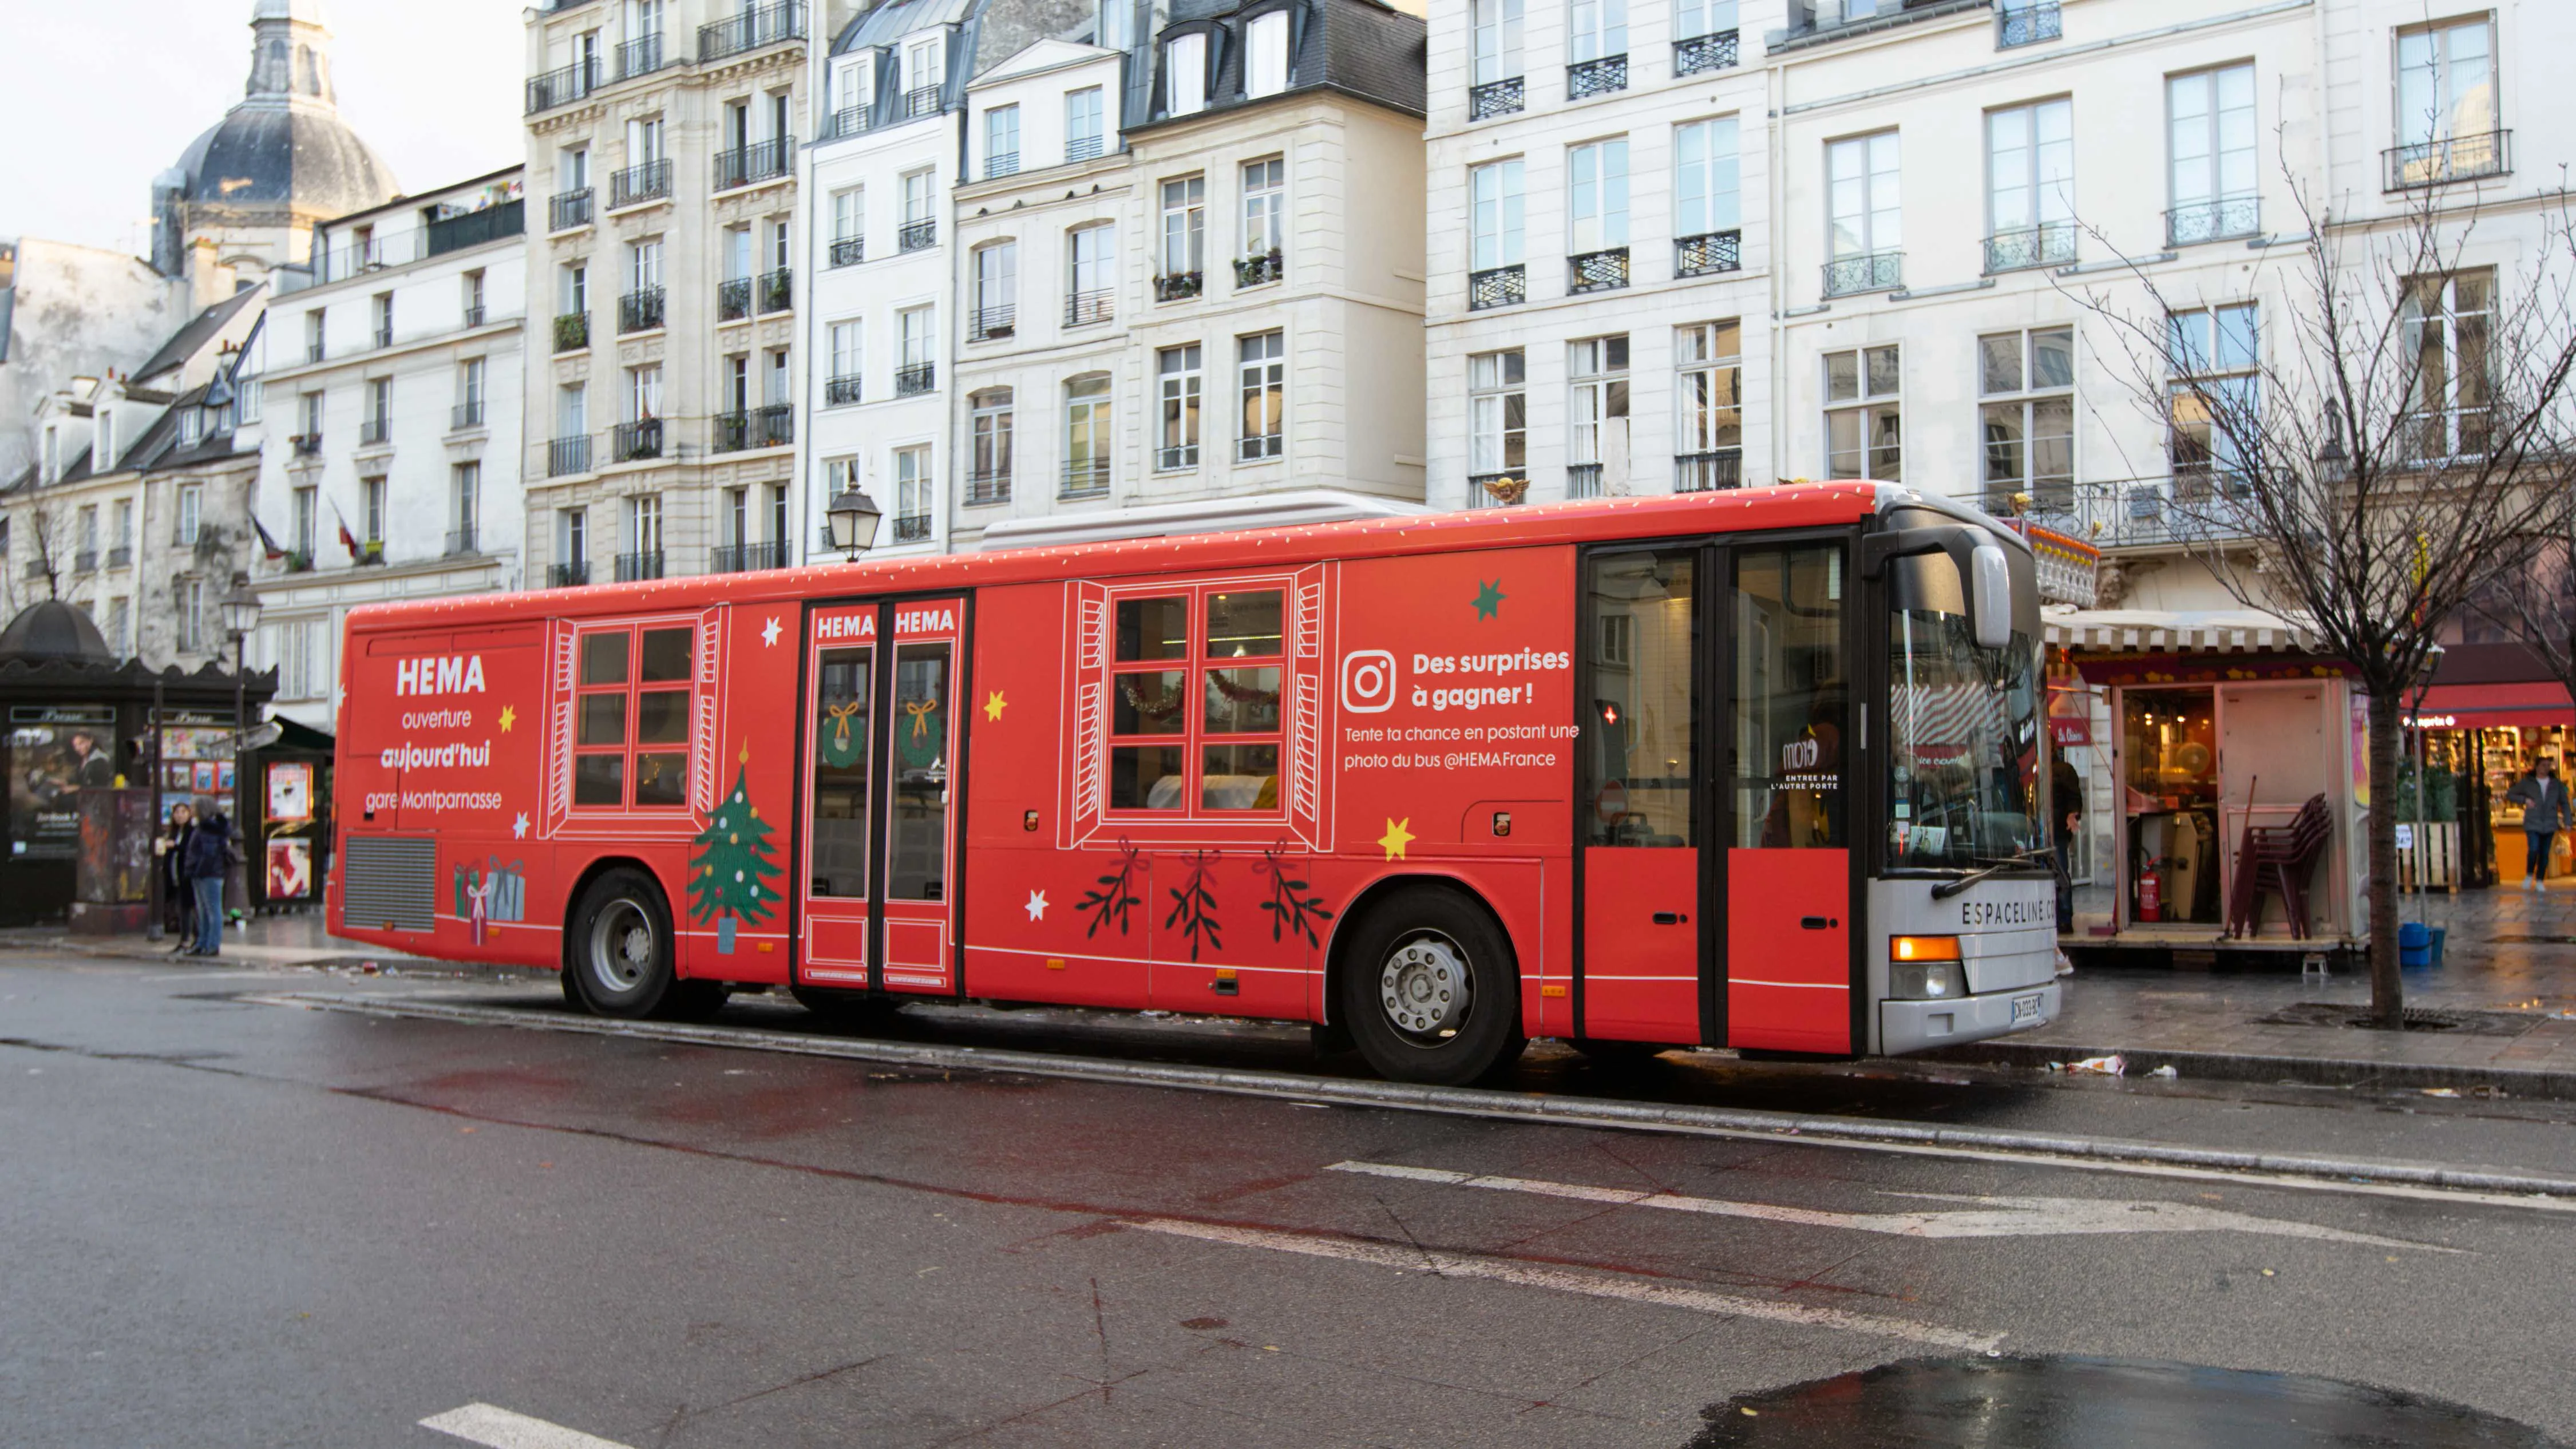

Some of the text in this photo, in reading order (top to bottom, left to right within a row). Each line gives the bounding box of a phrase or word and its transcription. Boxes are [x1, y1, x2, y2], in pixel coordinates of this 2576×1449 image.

[818, 615, 875, 638] HEMA
[895, 609, 955, 634] HEMA
[1414, 647, 1569, 676] Des surprises
[397, 655, 485, 696] HEMA
[1412, 684, 1427, 707] à
[1433, 687, 1522, 711] gagner
[402, 708, 472, 729] ouverture
[1345, 724, 1579, 743] Tente ta chance en postant une
[381, 739, 490, 773] aujourd'hui
[1345, 752, 1556, 771] photo du bus @HEMAFrance
[366, 791, 502, 813] gare Montparnasse
